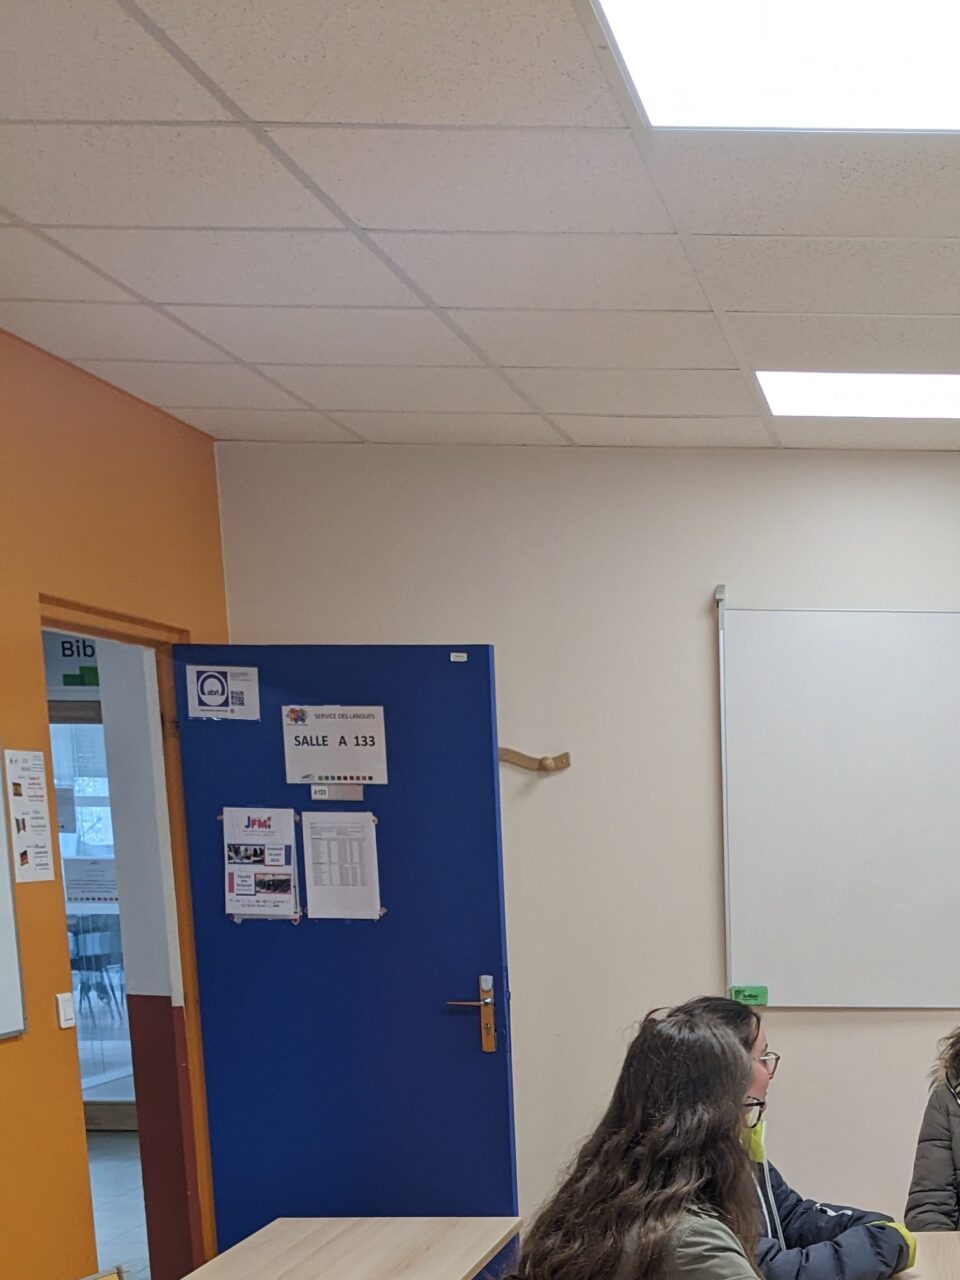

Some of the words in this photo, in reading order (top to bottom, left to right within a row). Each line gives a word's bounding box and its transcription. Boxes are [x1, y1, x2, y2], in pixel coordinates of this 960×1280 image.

[61, 639, 95, 658] Bib
[294, 735, 329, 747] SALLE
[338, 735, 347, 747] A
[354, 735, 376, 747] 133
